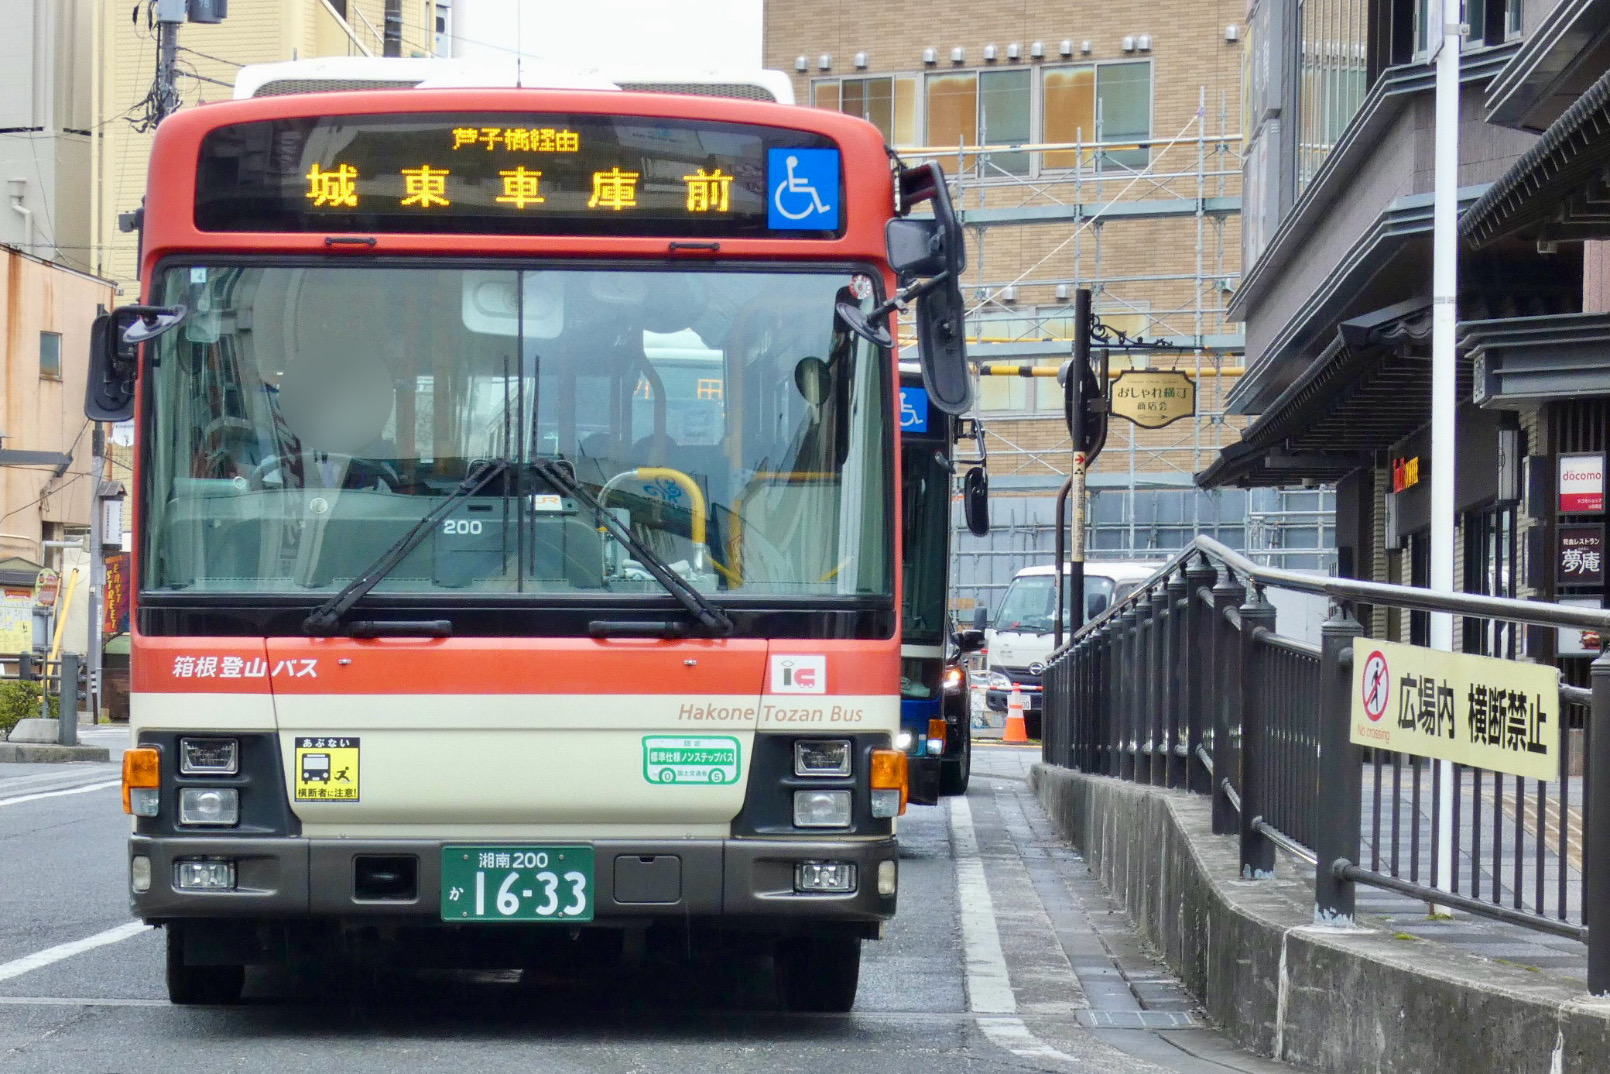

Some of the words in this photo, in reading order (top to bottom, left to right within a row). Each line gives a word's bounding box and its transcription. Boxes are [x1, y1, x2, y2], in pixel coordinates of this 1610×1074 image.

[452, 127, 579, 152] 芦子橋経由
[306, 163, 734, 212] 城東車庫前
[1562, 471, 1601, 481] docomo
[443, 520, 482, 535] 200
[1562, 549, 1600, 574] 夢庵
[172, 656, 319, 678] 箱根登山バス
[678, 703, 755, 721] Hakone
[763, 704, 823, 722] Tozan
[829, 705, 863, 722] Bus
[1397, 673, 1455, 739] 広場内
[1468, 683, 1547, 755] 横断禁止
[303, 738, 350, 748] あぶない
[449, 887, 464, 901] か
[476, 871, 586, 916] 16-33
